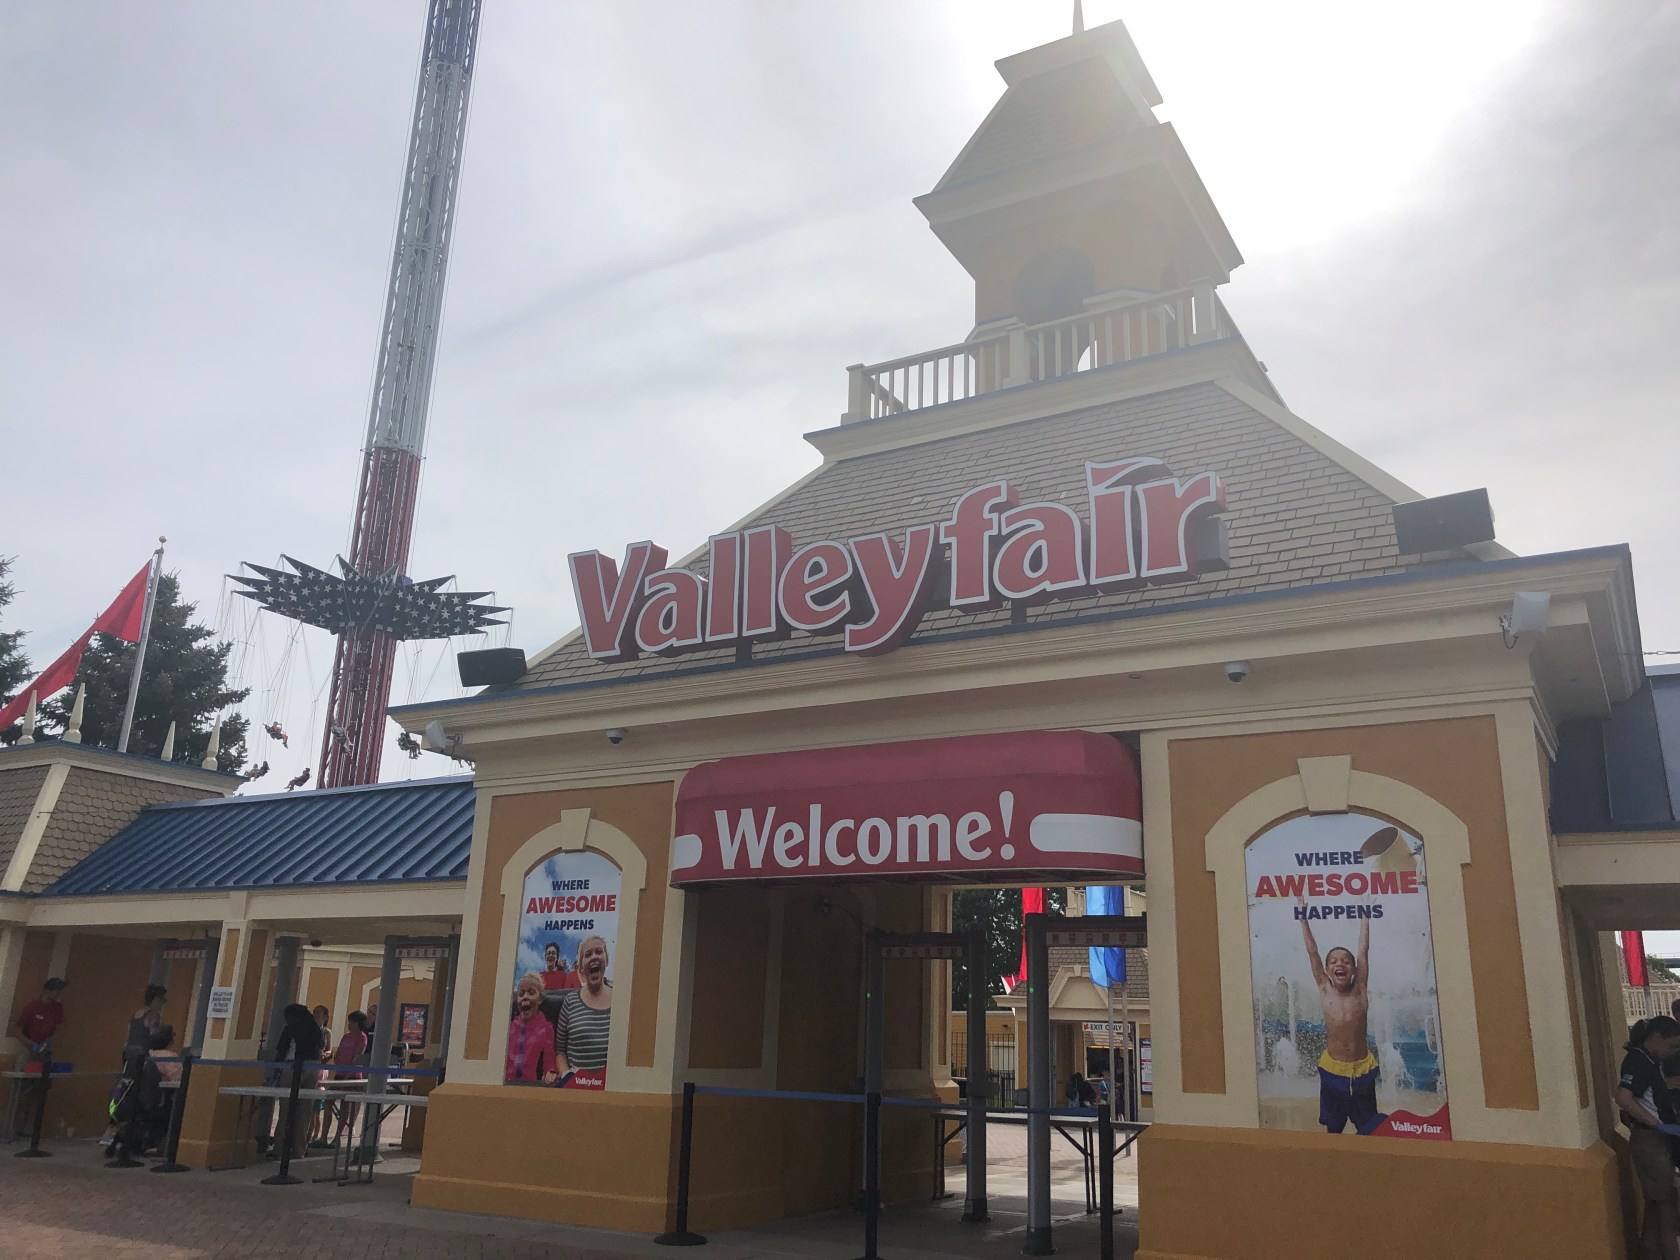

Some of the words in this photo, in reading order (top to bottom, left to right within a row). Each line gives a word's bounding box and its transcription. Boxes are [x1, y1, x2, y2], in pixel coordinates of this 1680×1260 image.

[568, 457, 1222, 658] Valleyfair
[714, 790, 1015, 871] Welcome!
[1294, 850, 1364, 867] WHERE
[551, 879, 590, 891] WHERE
[1255, 870, 1419, 898] AWESOME
[525, 894, 617, 914] AWESOME
[1293, 904, 1384, 920] HAPPENS
[544, 919, 595, 931] HAPPENS
[575, 1077, 603, 1087] Valleyfair
[1390, 1120, 1442, 1135] Valleyfair
